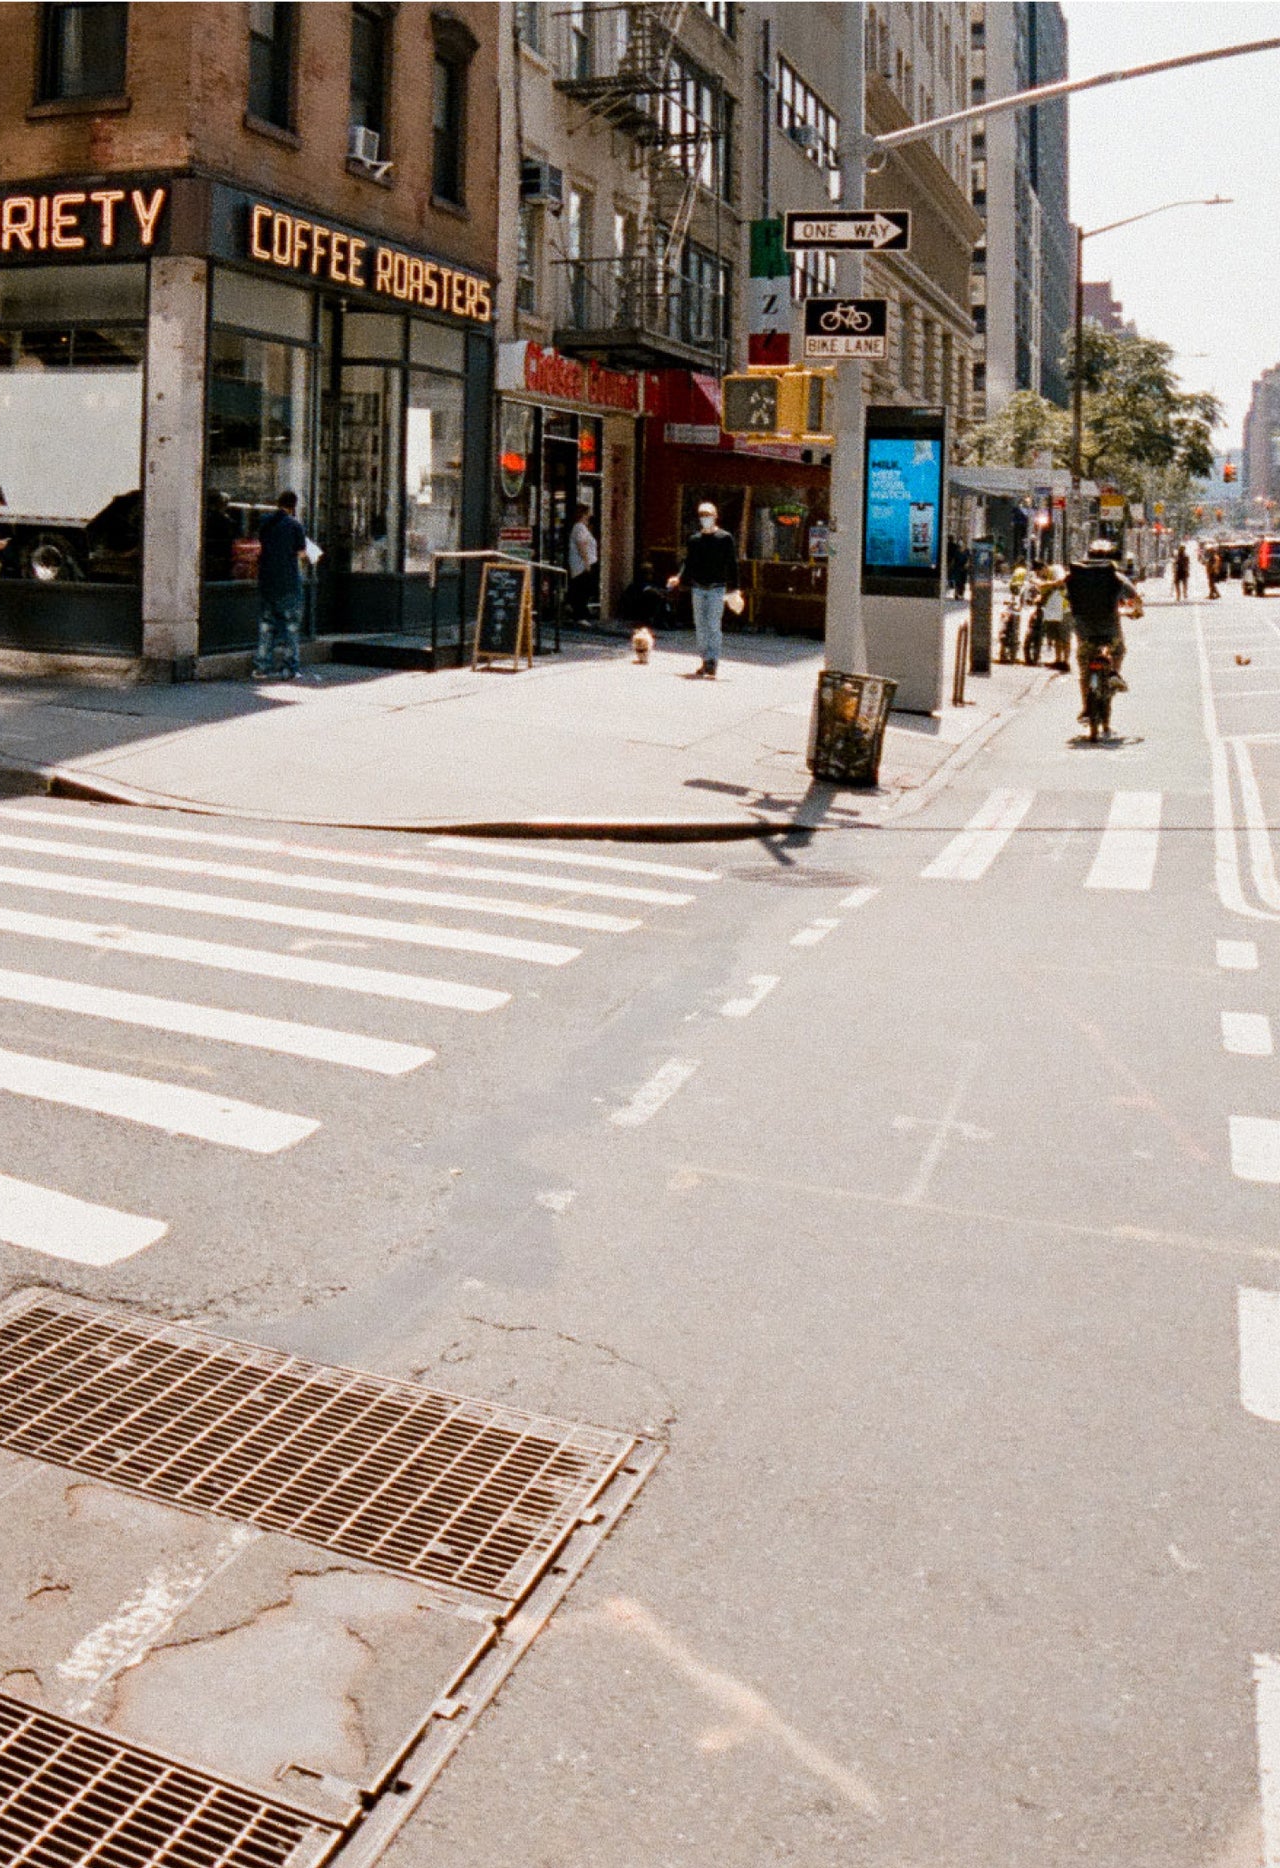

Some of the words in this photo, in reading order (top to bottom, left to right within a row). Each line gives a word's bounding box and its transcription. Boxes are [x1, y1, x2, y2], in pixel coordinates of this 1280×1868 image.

[802, 223, 838, 239] ONE
[854, 223, 890, 239] WAY
[250, 203, 367, 288] COFFEE
[375, 246, 492, 323] ROASTERS
[808, 337, 838, 353] BIKE
[844, 337, 882, 353] LANE
